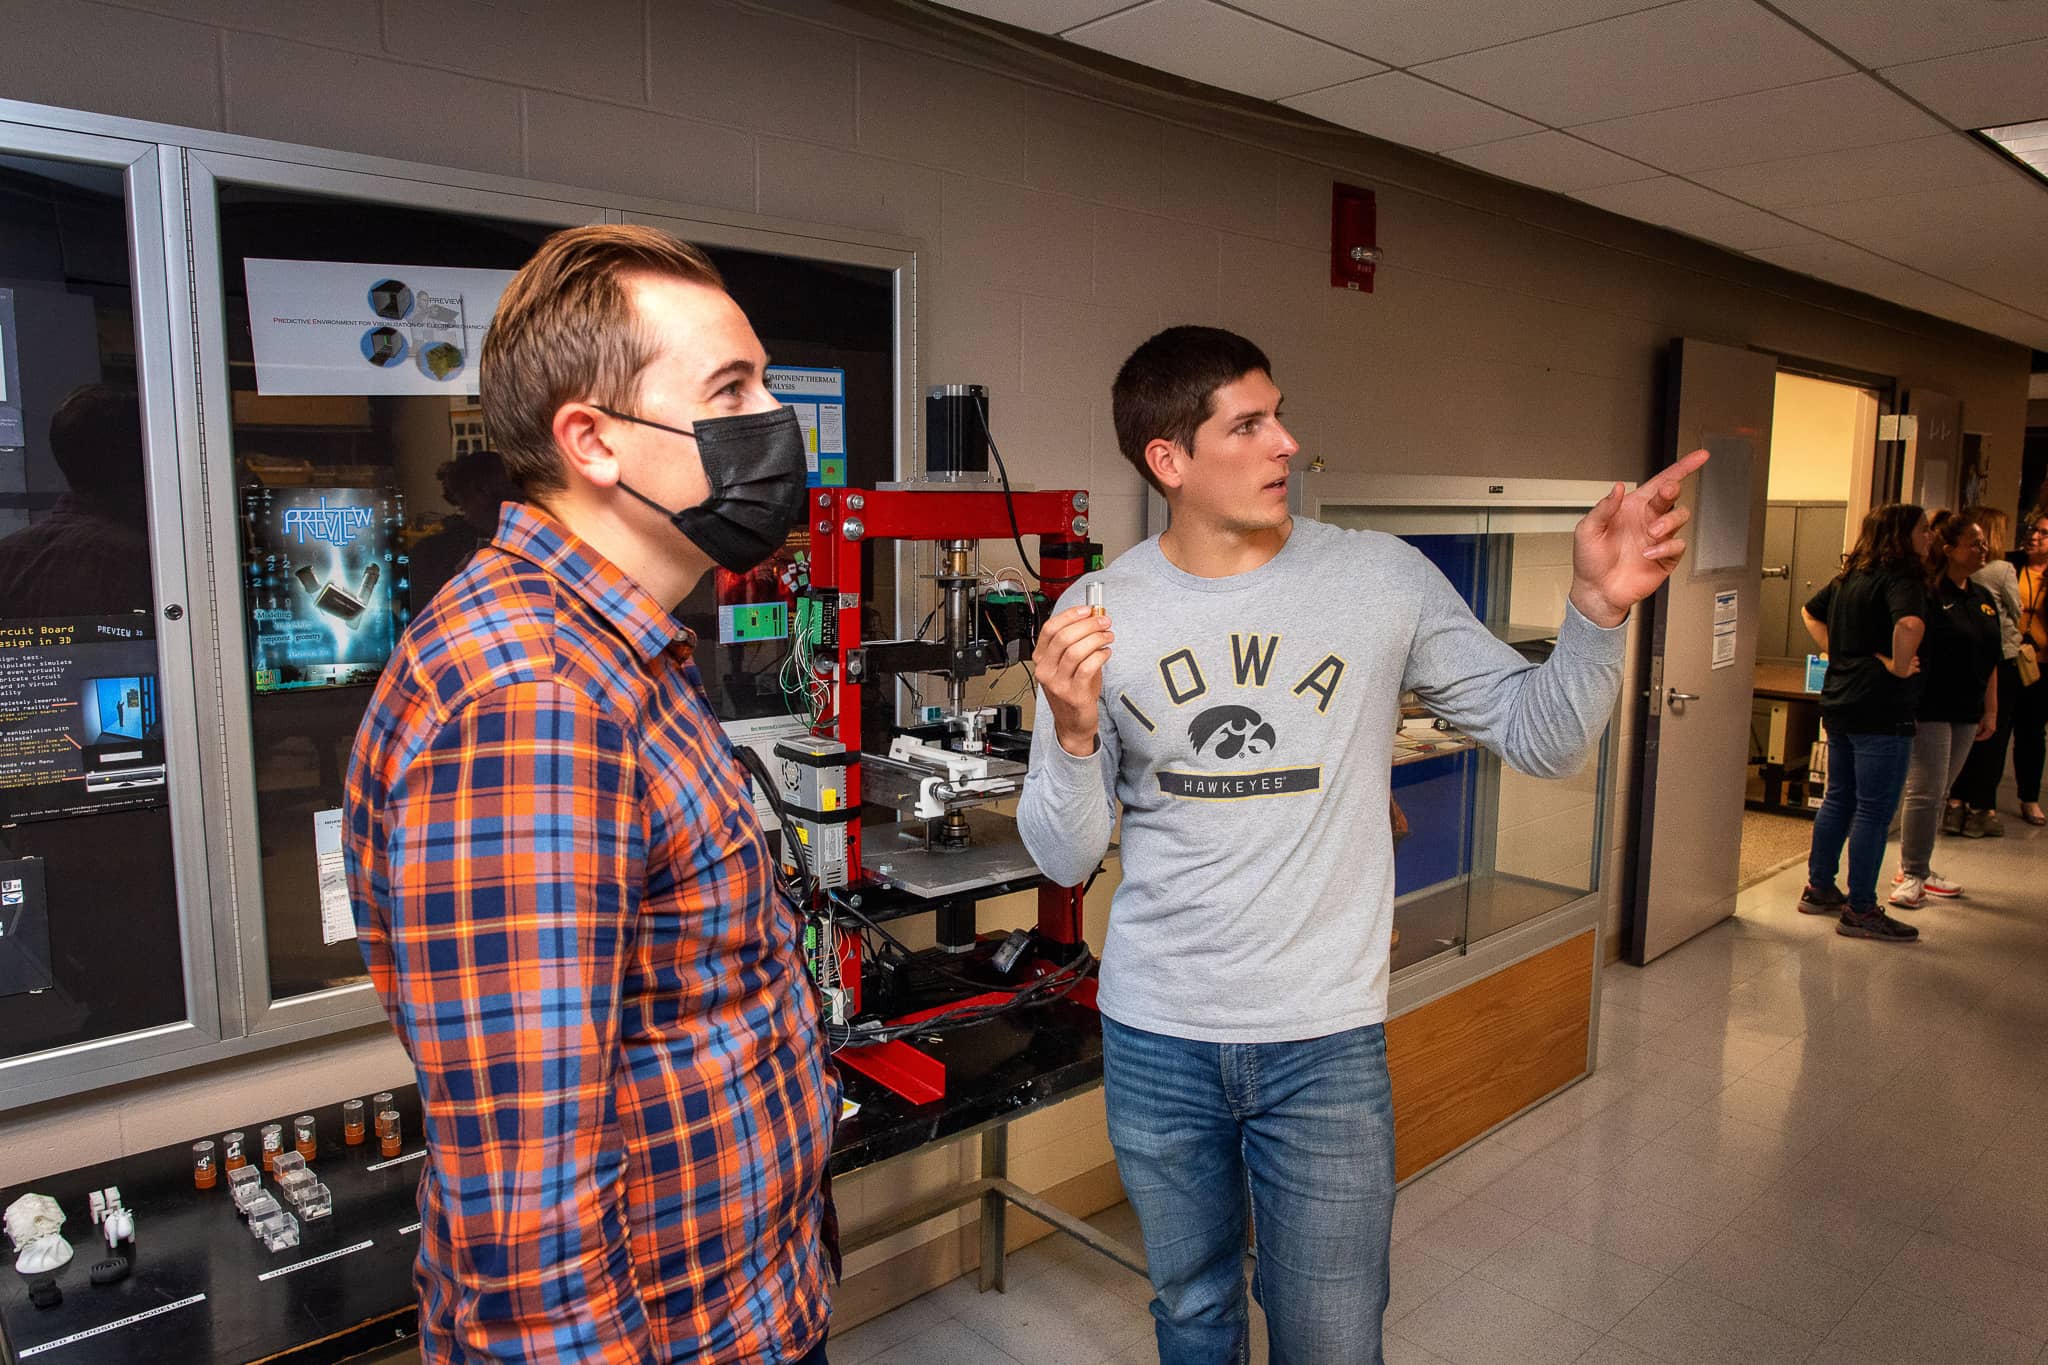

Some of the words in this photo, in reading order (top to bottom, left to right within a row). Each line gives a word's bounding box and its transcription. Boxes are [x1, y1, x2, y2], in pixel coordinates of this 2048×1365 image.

[429, 297, 463, 305] PREVIEW
[273, 317, 310, 325] PREDICTIVE
[312, 318, 358, 326] ENVIRONMENT
[806, 376, 837, 384] THERMAL
[41, 625, 74, 634] Board
[97, 625, 131, 637] PREVIEW
[40, 637, 52, 646] in
[59, 636, 71, 645] 3D
[1119, 632, 1348, 735] IOWA
[1184, 777, 1283, 793] HAWKEYES
[31, 1338, 67, 1353] FUSED
[72, 1317, 134, 1340] DEPOSITION
